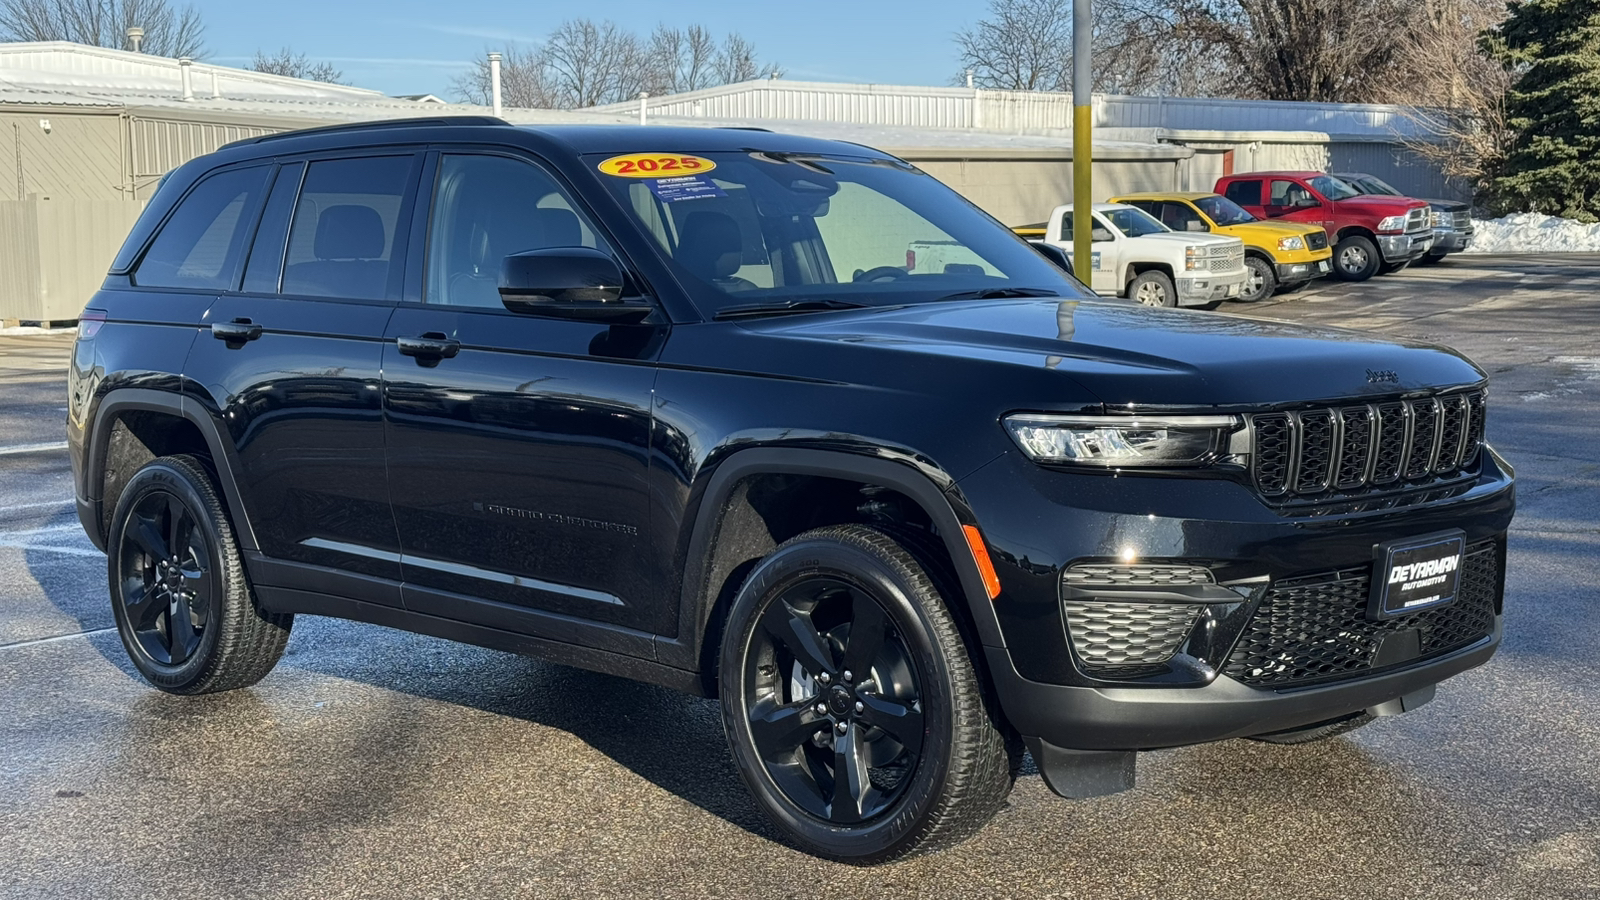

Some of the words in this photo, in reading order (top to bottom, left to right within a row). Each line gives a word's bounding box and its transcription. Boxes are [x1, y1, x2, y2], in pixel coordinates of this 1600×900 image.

[615, 157, 702, 174] 2025
[1365, 368, 1399, 384] Jeep
[488, 504, 543, 519] GRAND
[547, 513, 638, 536] CHEROKEE
[1388, 554, 1460, 584] DEYARMAN
[1401, 574, 1448, 591] AUTOMOTIVE
